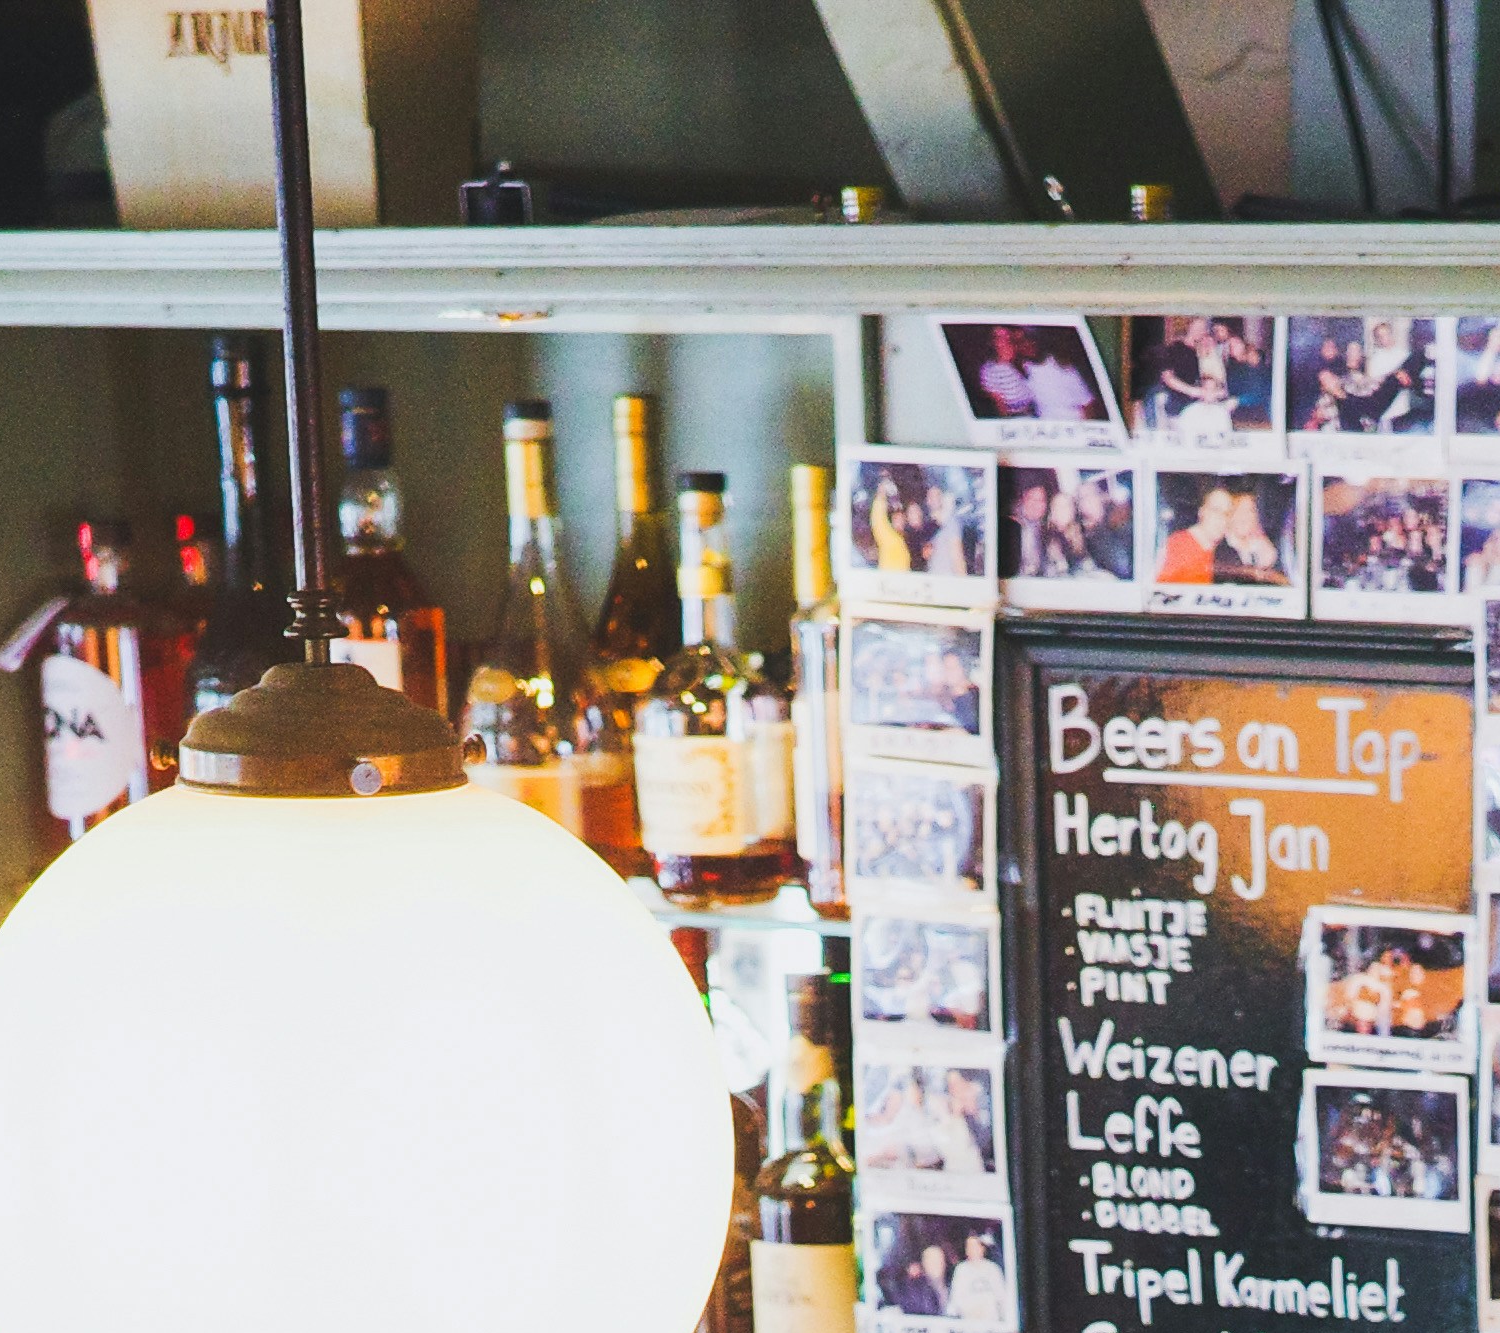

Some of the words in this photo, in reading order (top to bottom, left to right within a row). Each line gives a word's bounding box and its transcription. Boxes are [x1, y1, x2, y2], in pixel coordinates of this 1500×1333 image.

[1048, 684, 1226, 776] Beers
[1236, 721, 1299, 774] on
[1318, 698, 1421, 803] Tap
[1053, 791, 1219, 895] Hertog
[1230, 800, 1331, 901] Jan
[1080, 966, 1173, 1007] PINT
[1057, 1016, 1279, 1092] Weizener
[1066, 1090, 1203, 1160] Leffe
[1092, 1162, 1196, 1200] BLOND
[1069, 1240, 1201, 1325] Tripel
[1213, 1250, 1406, 1323] Karmeliet
